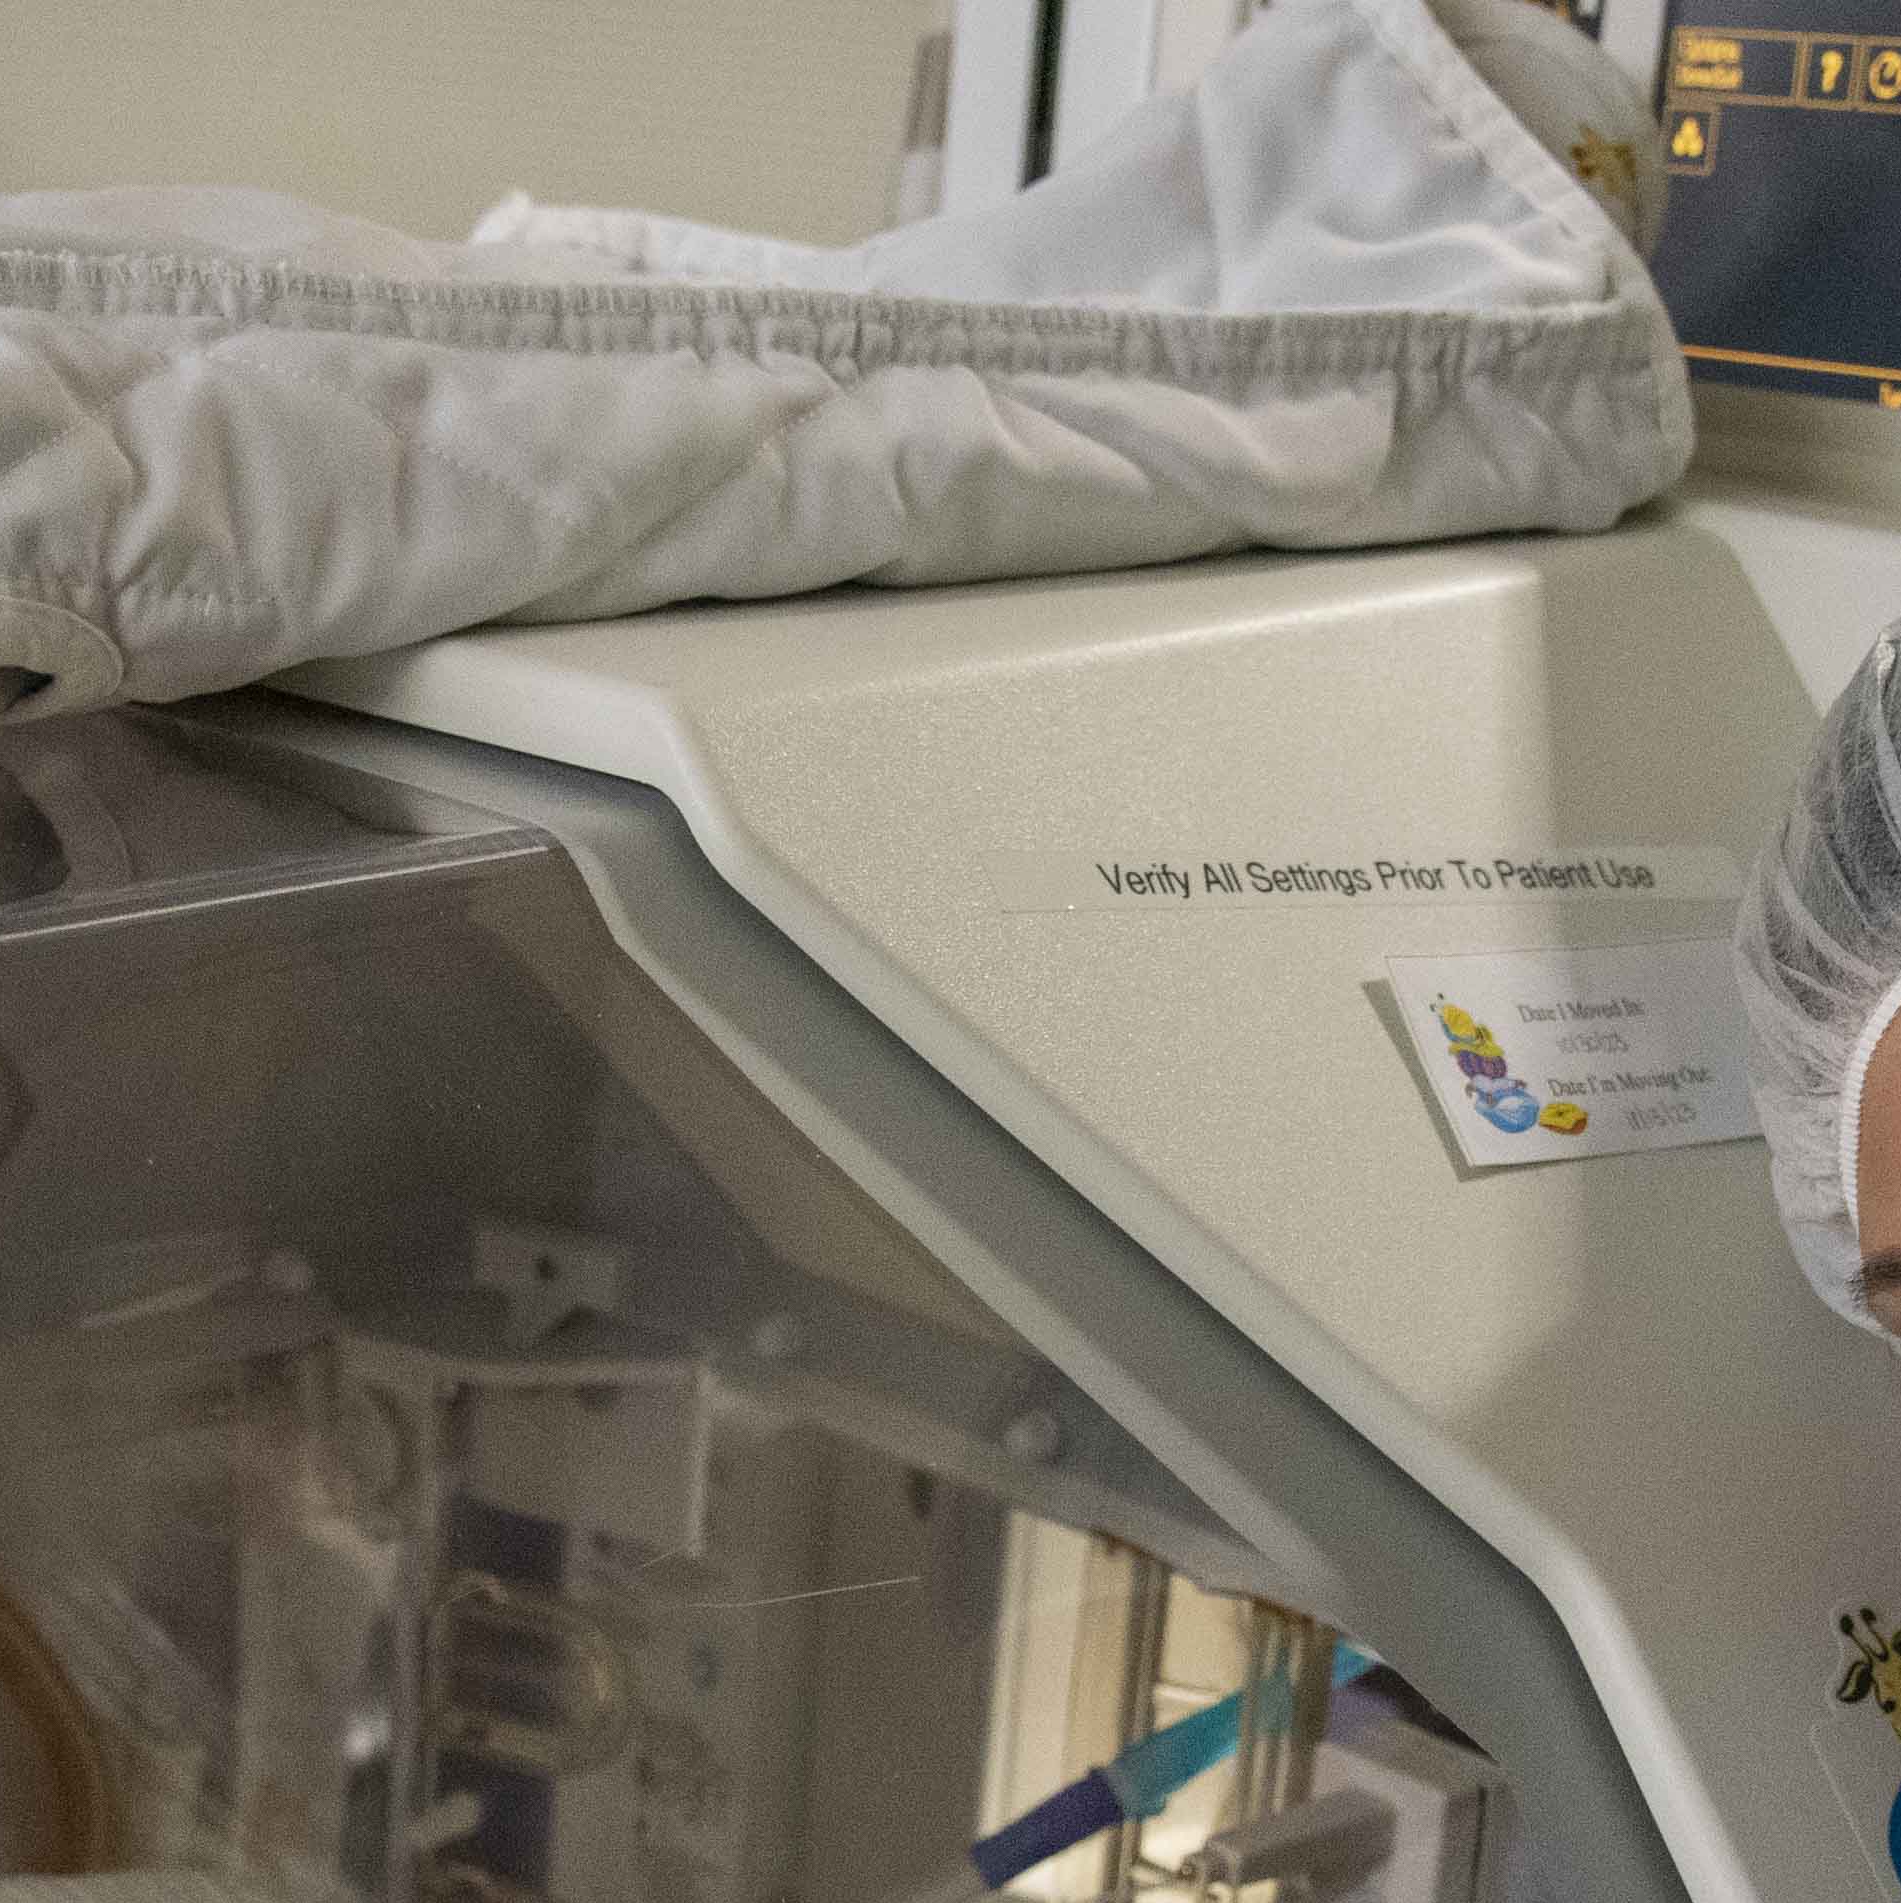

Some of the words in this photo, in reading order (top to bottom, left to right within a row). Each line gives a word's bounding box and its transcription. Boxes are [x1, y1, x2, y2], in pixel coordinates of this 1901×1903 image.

[1095, 862, 1190, 898] Verify
[1202, 862, 1243, 893] All
[1246, 861, 1372, 896] Settings
[1375, 860, 1445, 890] Prior
[1447, 859, 1492, 889] To
[1493, 859, 1596, 889] Patient
[1596, 858, 1655, 888] Use
[1517, 1004, 1556, 1023] Date
[1547, 1079, 1588, 1097] Date
